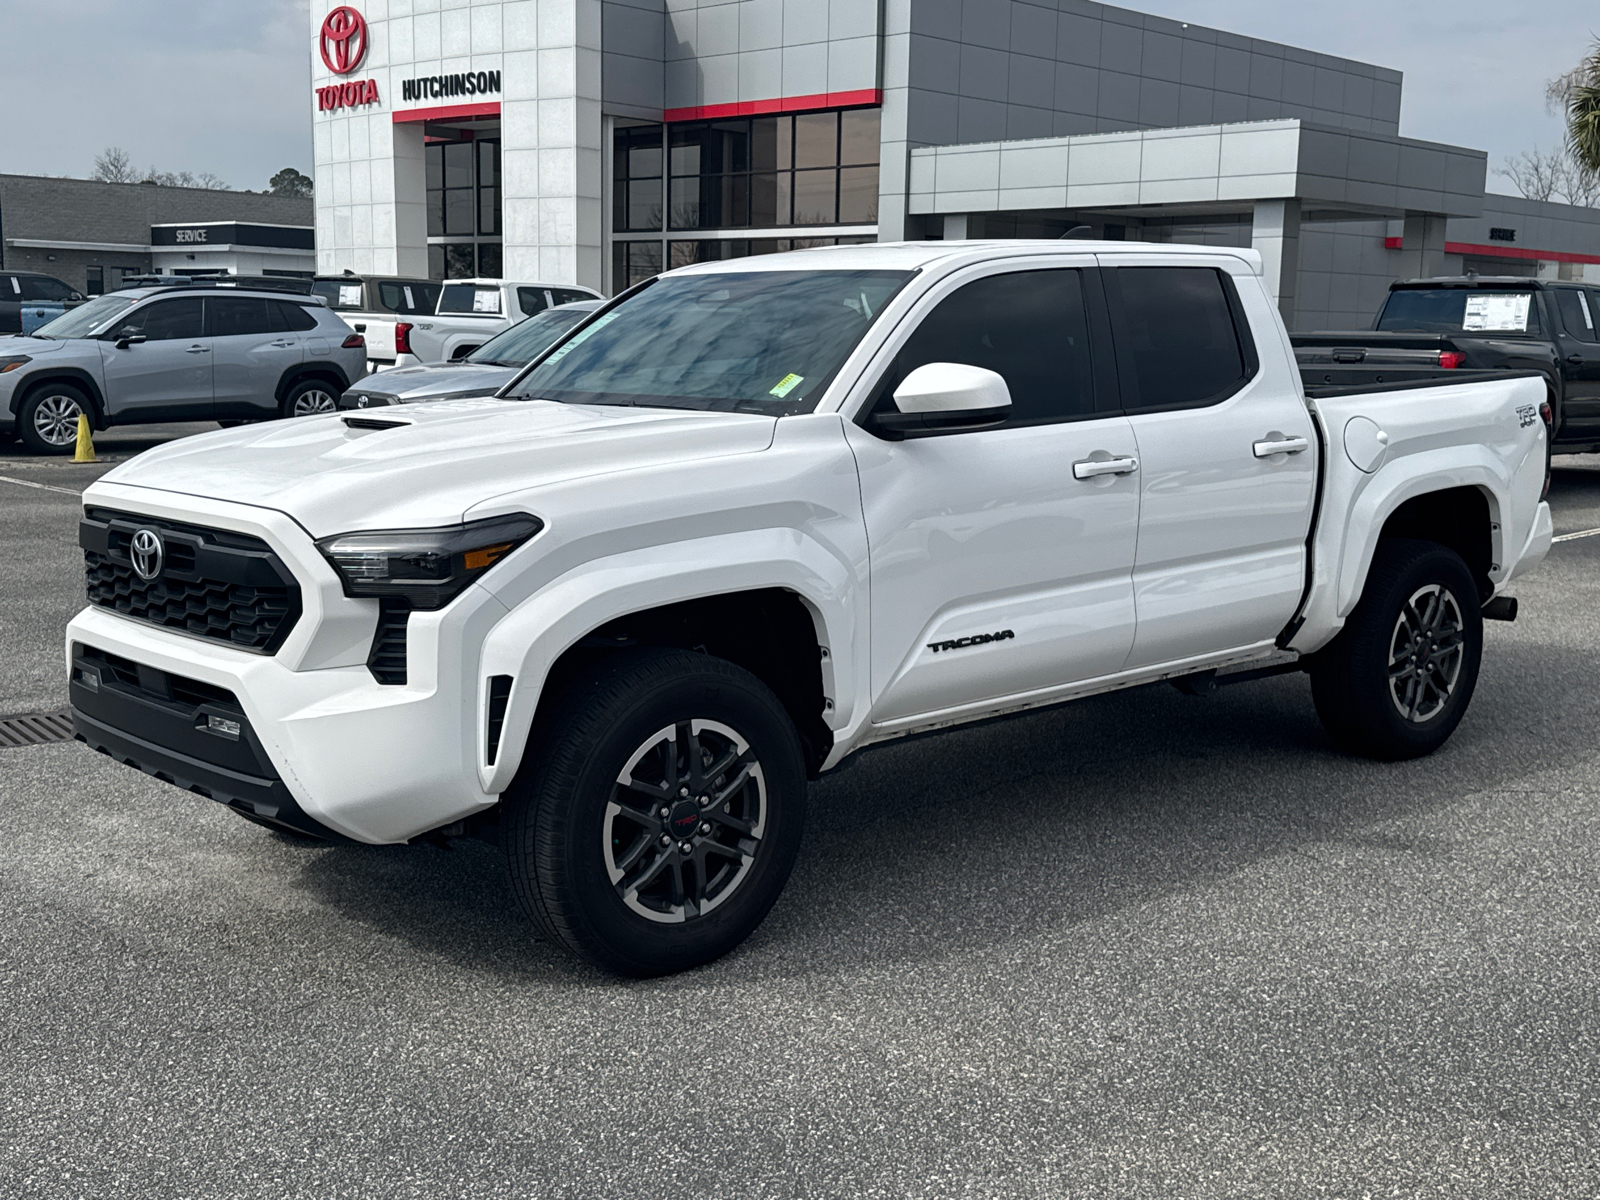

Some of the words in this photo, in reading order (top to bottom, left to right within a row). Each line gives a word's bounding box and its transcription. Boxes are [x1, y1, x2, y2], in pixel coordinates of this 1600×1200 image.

[315, 79, 379, 111] TOYOTA
[402, 70, 501, 101] HUTCHINSON
[176, 229, 207, 242] SERVICE
[1515, 403, 1537, 420] TRD
[926, 629, 1015, 653] TACOMA
[675, 814, 698, 826] TRD
